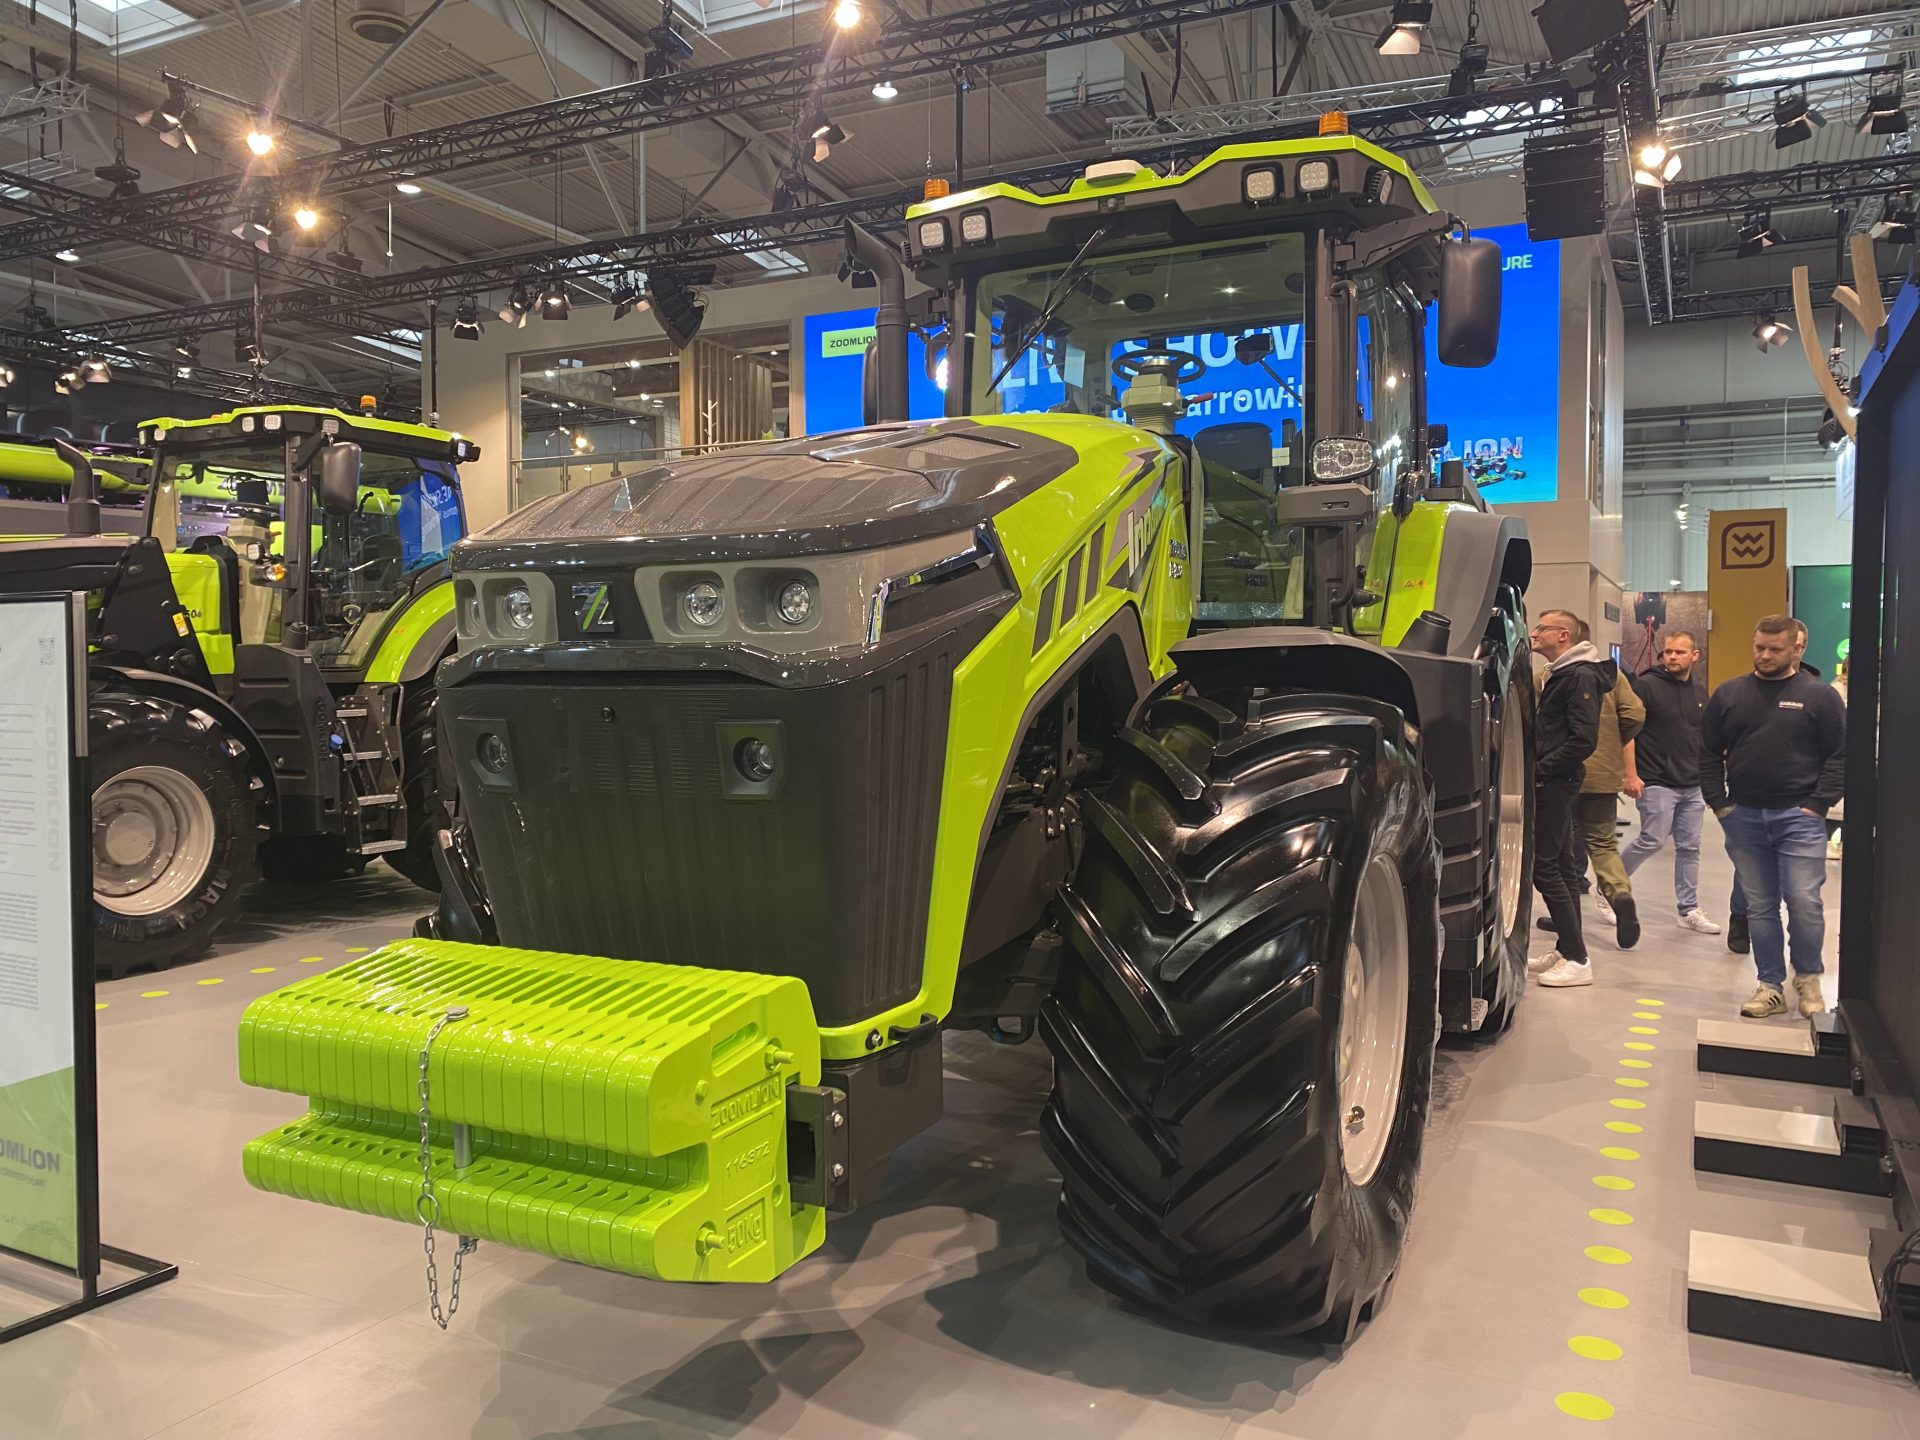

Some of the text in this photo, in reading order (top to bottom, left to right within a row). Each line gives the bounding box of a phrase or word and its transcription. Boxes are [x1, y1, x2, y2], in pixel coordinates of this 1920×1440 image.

[1502, 254, 1533, 271] URE
[1178, 376, 1303, 418] arrowi
[45, 704, 61, 872] ZOOMLION
[711, 1076, 780, 1132] ZOOMLION
